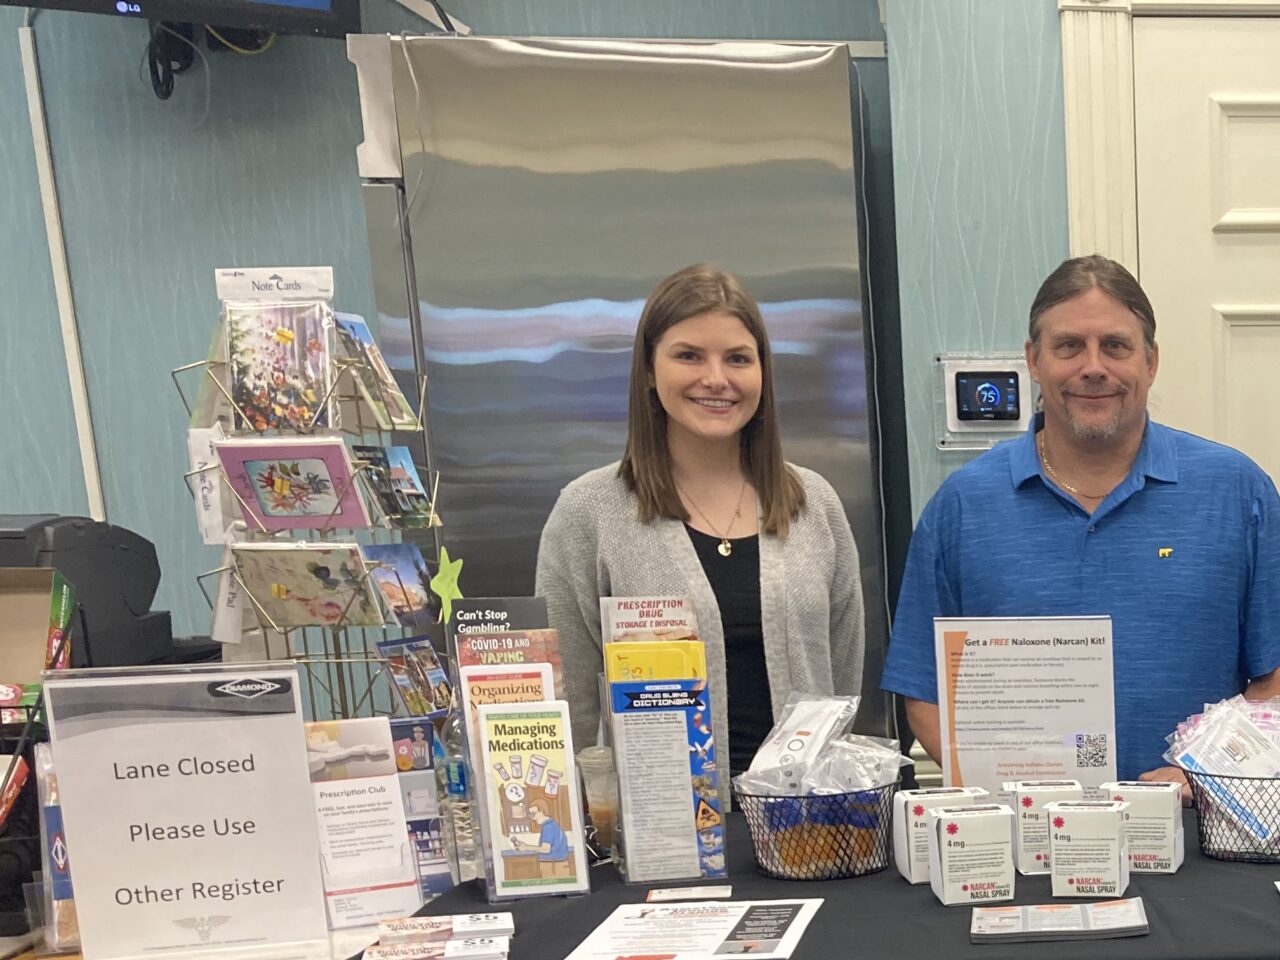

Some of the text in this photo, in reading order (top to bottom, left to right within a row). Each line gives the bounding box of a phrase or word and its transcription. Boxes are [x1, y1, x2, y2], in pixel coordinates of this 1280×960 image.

[128, 4, 141, 12] LG
[252, 280, 301, 291] Note Cards
[981, 392, 995, 403] 75
[617, 600, 682, 610] PRESCRIPTION
[456, 610, 507, 620] Can't Stop
[639, 610, 663, 618] DRUG
[458, 622, 510, 633] Gambling?
[471, 638, 530, 650] COVID-19 AND
[965, 638, 980, 647] Get
[989, 638, 1010, 646] FREE
[1012, 638, 1051, 646] Naloxone
[1053, 637, 1088, 647] (Narcan)
[1090, 637, 1105, 645] Kit!
[480, 651, 524, 664] VAPING
[226, 684, 271, 692] DIAMOND
[471, 684, 541, 698] Organizing
[633, 699, 695, 707] DICTIONARY
[494, 722, 557, 738] Managing
[488, 738, 564, 752] Medications
[113, 754, 255, 780] Lane Closed
[320, 788, 367, 799] Prescription
[129, 818, 256, 842] Please Use
[1059, 834, 1071, 842] mg
[1153, 862, 1171, 870] SPRAY
[970, 882, 995, 890] NARCAN
[1097, 885, 1116, 893] SPRAY
[114, 878, 285, 906] Other Register
[970, 889, 1010, 899] NASAL SPRAY
